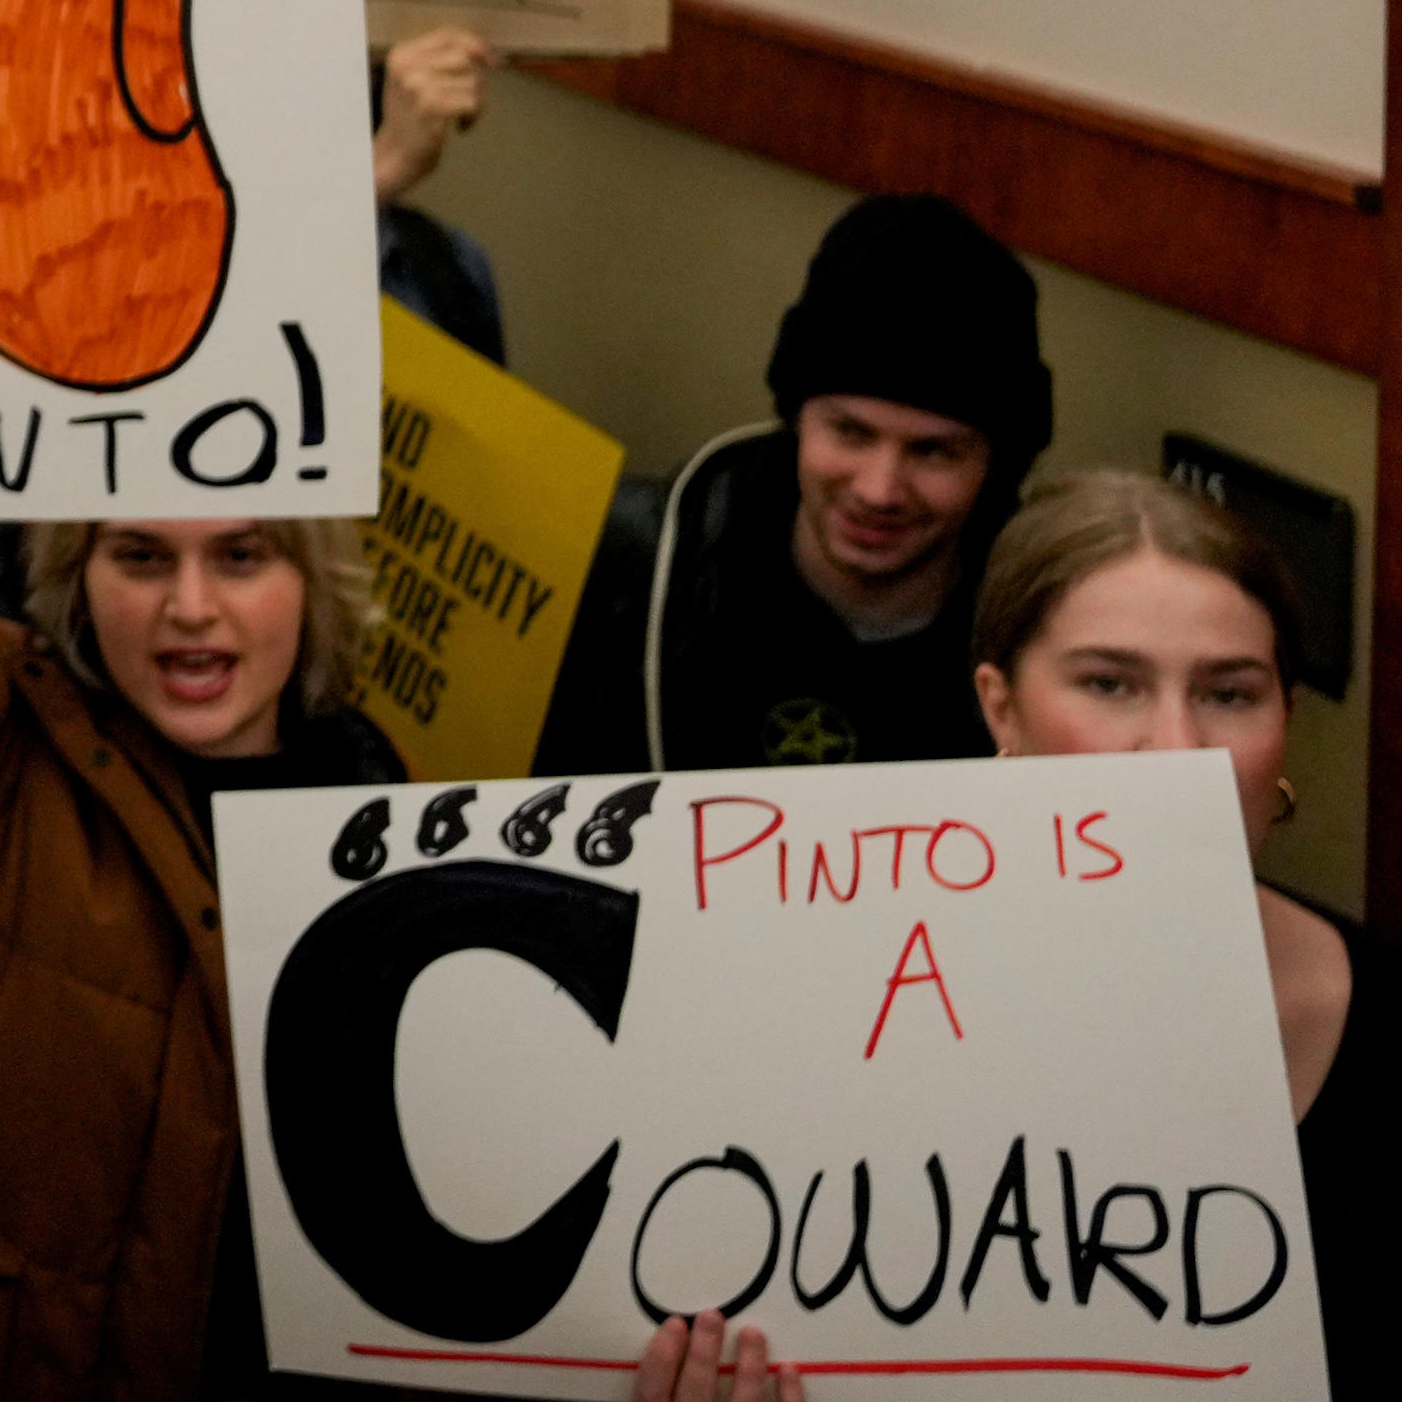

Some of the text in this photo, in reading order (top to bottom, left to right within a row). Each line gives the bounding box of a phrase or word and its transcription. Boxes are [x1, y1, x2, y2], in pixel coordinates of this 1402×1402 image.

[376, 470, 552, 638] MPLICITY
[689, 795, 1123, 911] PINTO IS
[863, 920, 964, 1061] A
[264, 858, 1290, 1345] COWARD
